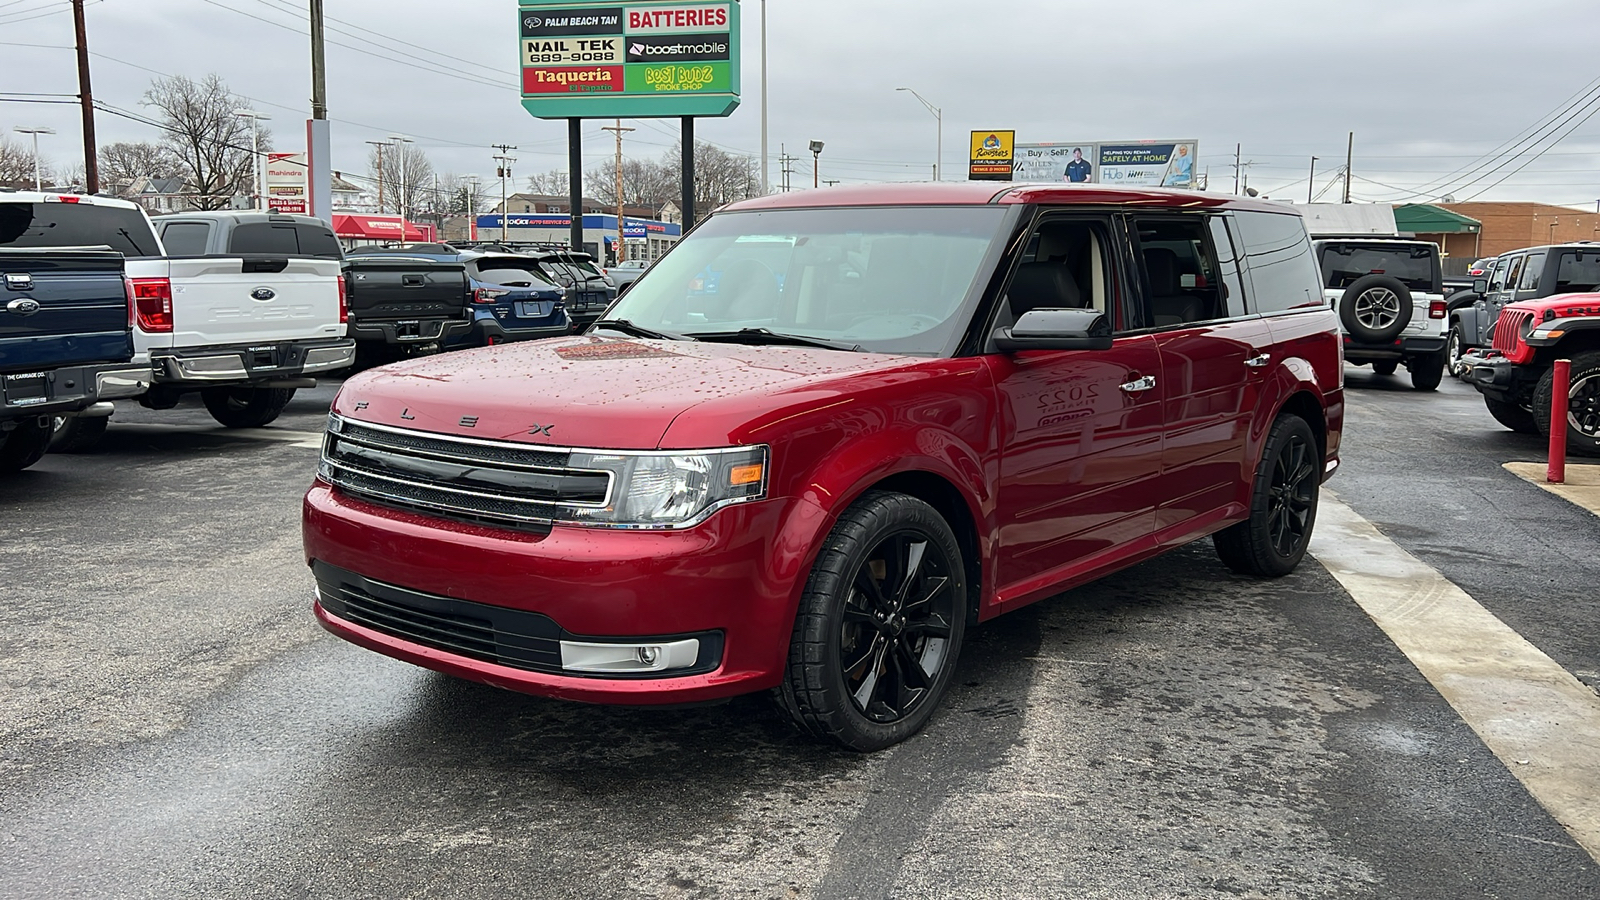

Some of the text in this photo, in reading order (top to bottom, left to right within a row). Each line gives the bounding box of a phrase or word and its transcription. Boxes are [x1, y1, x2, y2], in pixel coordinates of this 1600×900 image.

[544, 15, 618, 27] PALM BEACH TAN
[629, 8, 727, 29] BATTERIES
[527, 39, 616, 53] NAIL TEK
[530, 52, 614, 63] 689-9088
[677, 65, 714, 84] BUDZ
[654, 82, 703, 91] SMOKE SHOP
[975, 147, 1009, 158] Roosters
[1027, 150, 1043, 158] Buy
[1050, 148, 1069, 157] Sell?
[1102, 155, 1131, 163] SAFELY
[1143, 154, 1167, 162] HOME
[208, 304, 315, 322] F-150
[379, 304, 443, 312] TACOMA
[354, 401, 555, 437] FLEX
